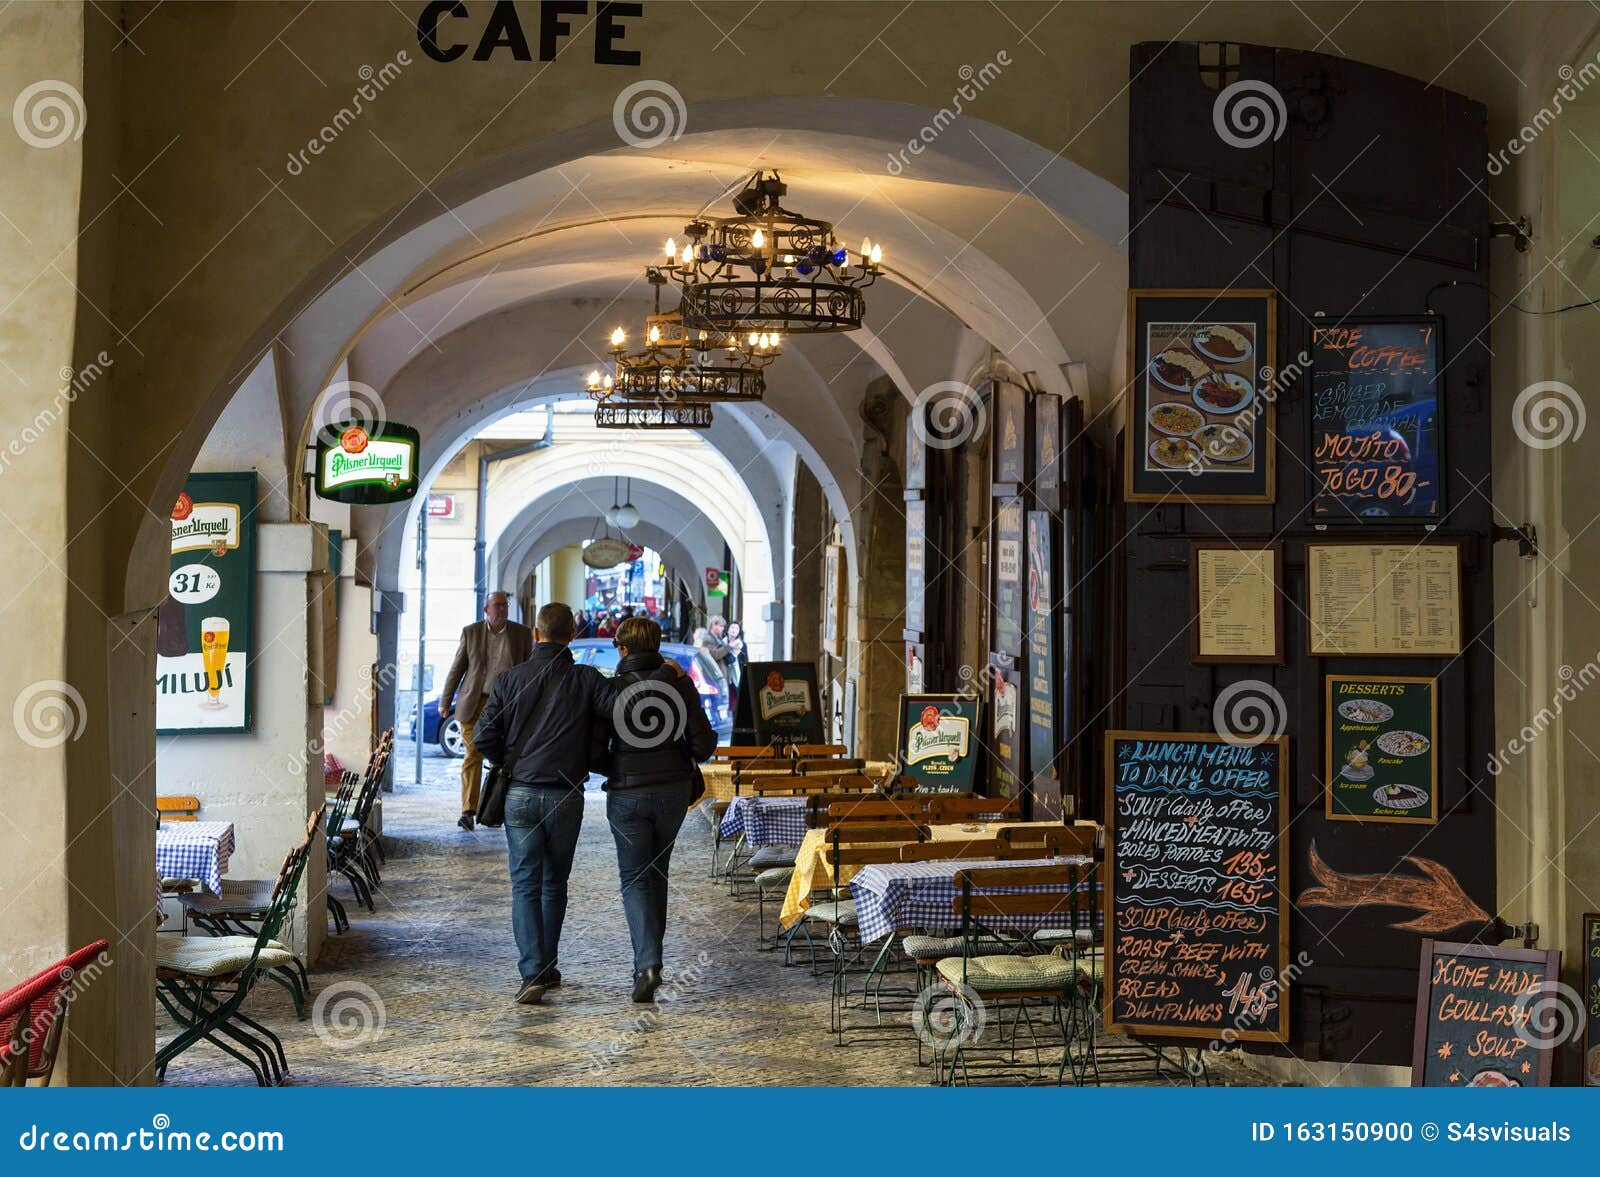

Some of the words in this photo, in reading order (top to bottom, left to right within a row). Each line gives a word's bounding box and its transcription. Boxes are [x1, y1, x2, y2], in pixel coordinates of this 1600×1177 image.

[417, 0, 643, 66] CAFE
[332, 452, 368, 478] Pilsner
[367, 452, 402, 471] Urquell
[192, 518, 229, 537] Urquell
[173, 573, 201, 593] 31
[1339, 683, 1406, 696] DESSERTS
[1132, 741, 1197, 763] LUNCH
[1198, 744, 1256, 768] MENU
[1209, 768, 1270, 788] OFFER
[1161, 843, 1223, 863] POTATOES
[1132, 869, 1217, 893] DESSERTS
[1117, 935, 1173, 959] ROAST
[1118, 978, 1180, 998] BREAD
[1433, 958, 1489, 988] HOME
[1489, 968, 1544, 996] MADE
[1438, 993, 1534, 1029] GOULASH
[1468, 1030, 1528, 1059] SOUP
